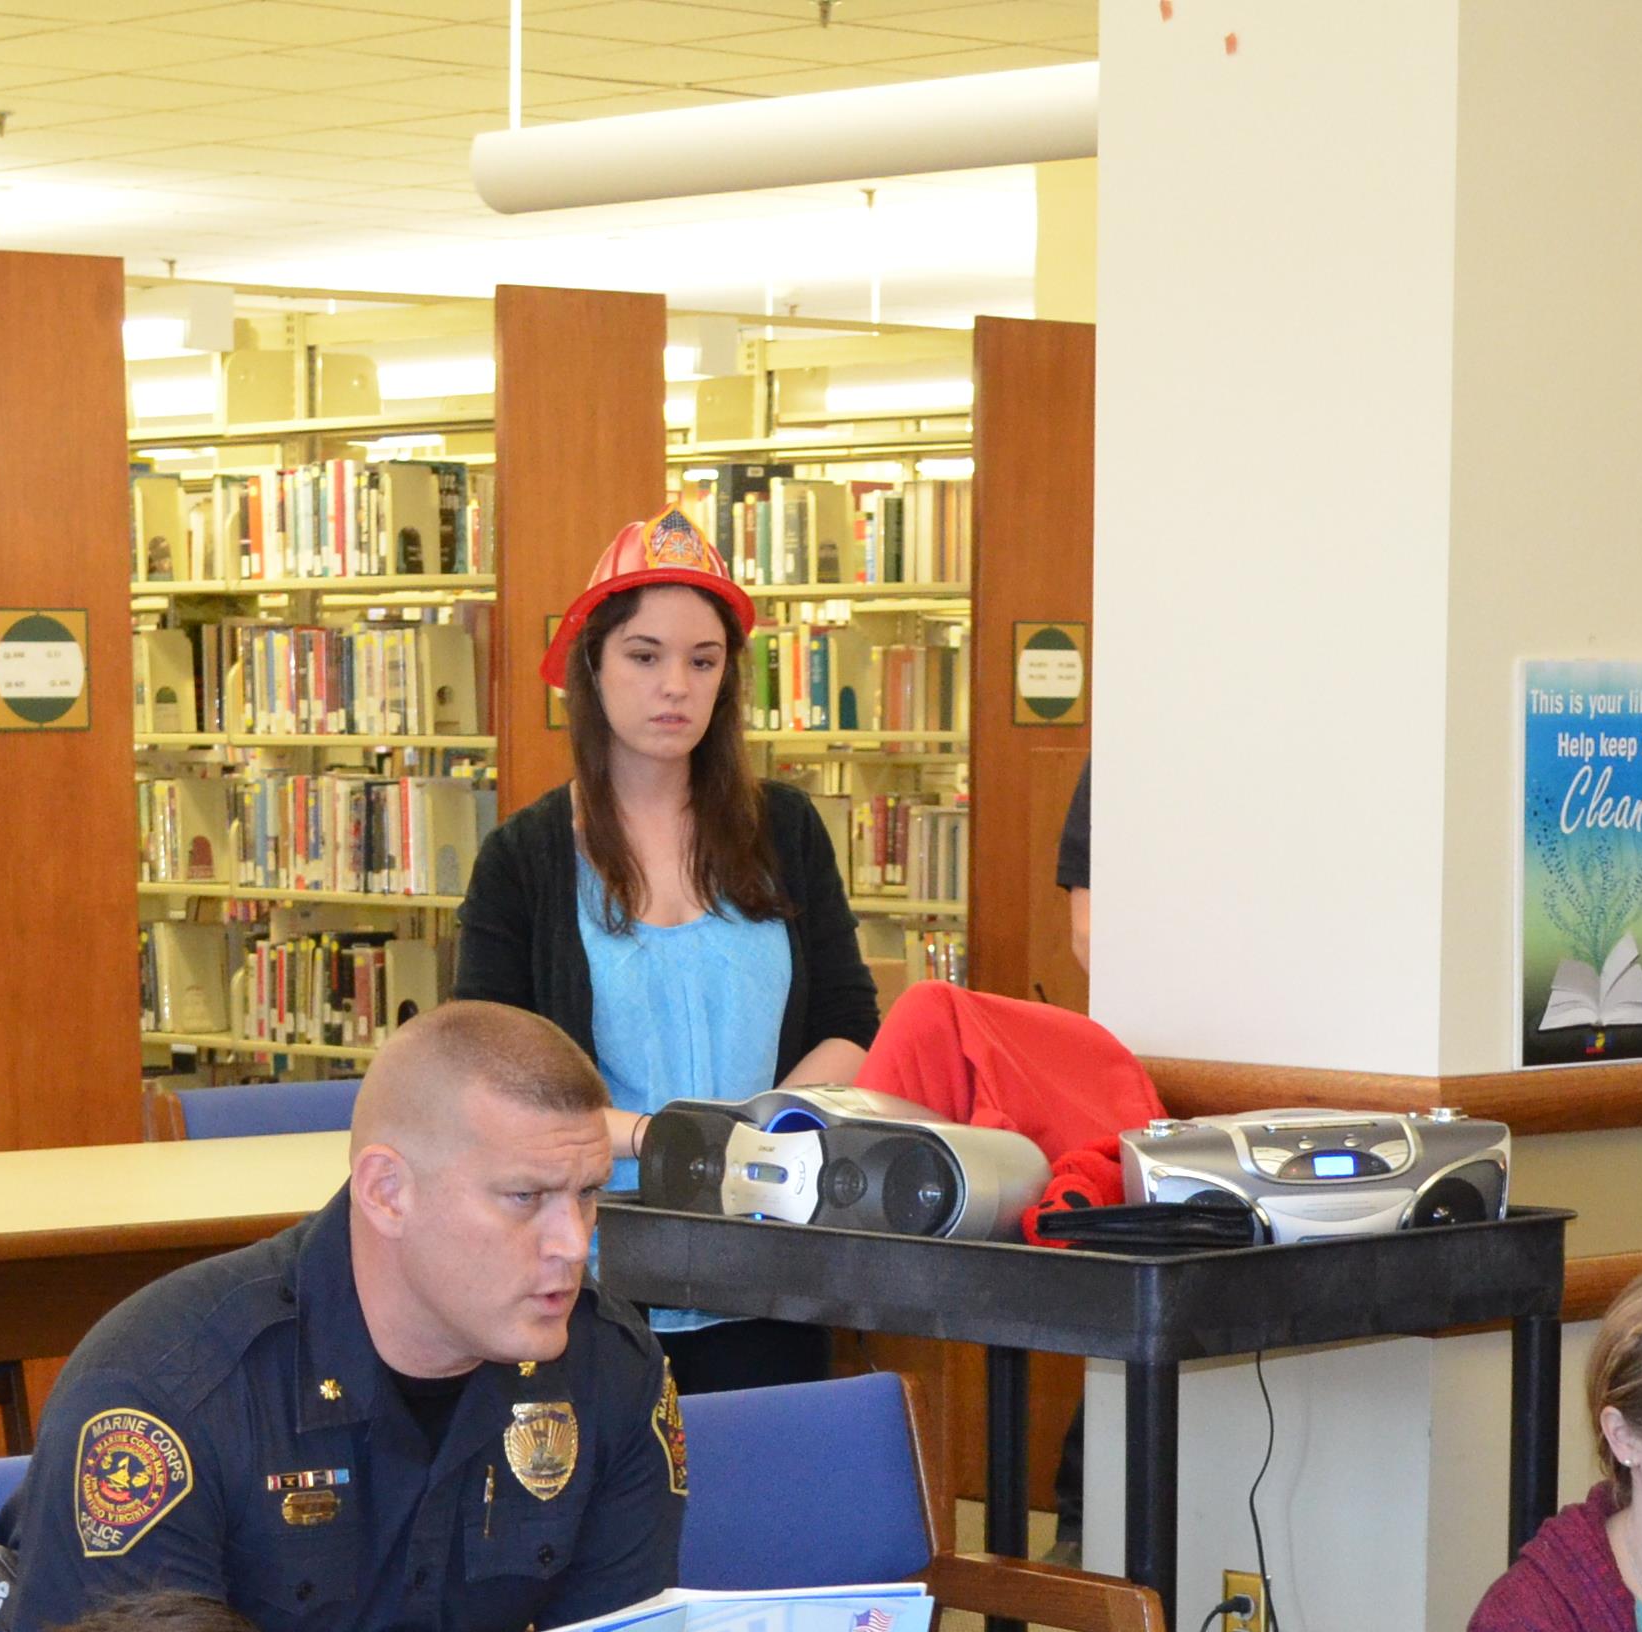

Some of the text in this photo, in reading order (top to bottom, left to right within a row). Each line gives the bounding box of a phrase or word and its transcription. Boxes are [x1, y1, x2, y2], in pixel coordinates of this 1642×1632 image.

[1531, 689, 1564, 714] This
[1569, 690, 1583, 714] is
[1589, 693, 1623, 720] your
[1557, 731, 1595, 763] Help
[1599, 732, 1637, 763] keep
[92, 1416, 149, 1439] MARINE
[150, 1430, 185, 1482] CORPS
[81, 1511, 124, 1546] POLICE
